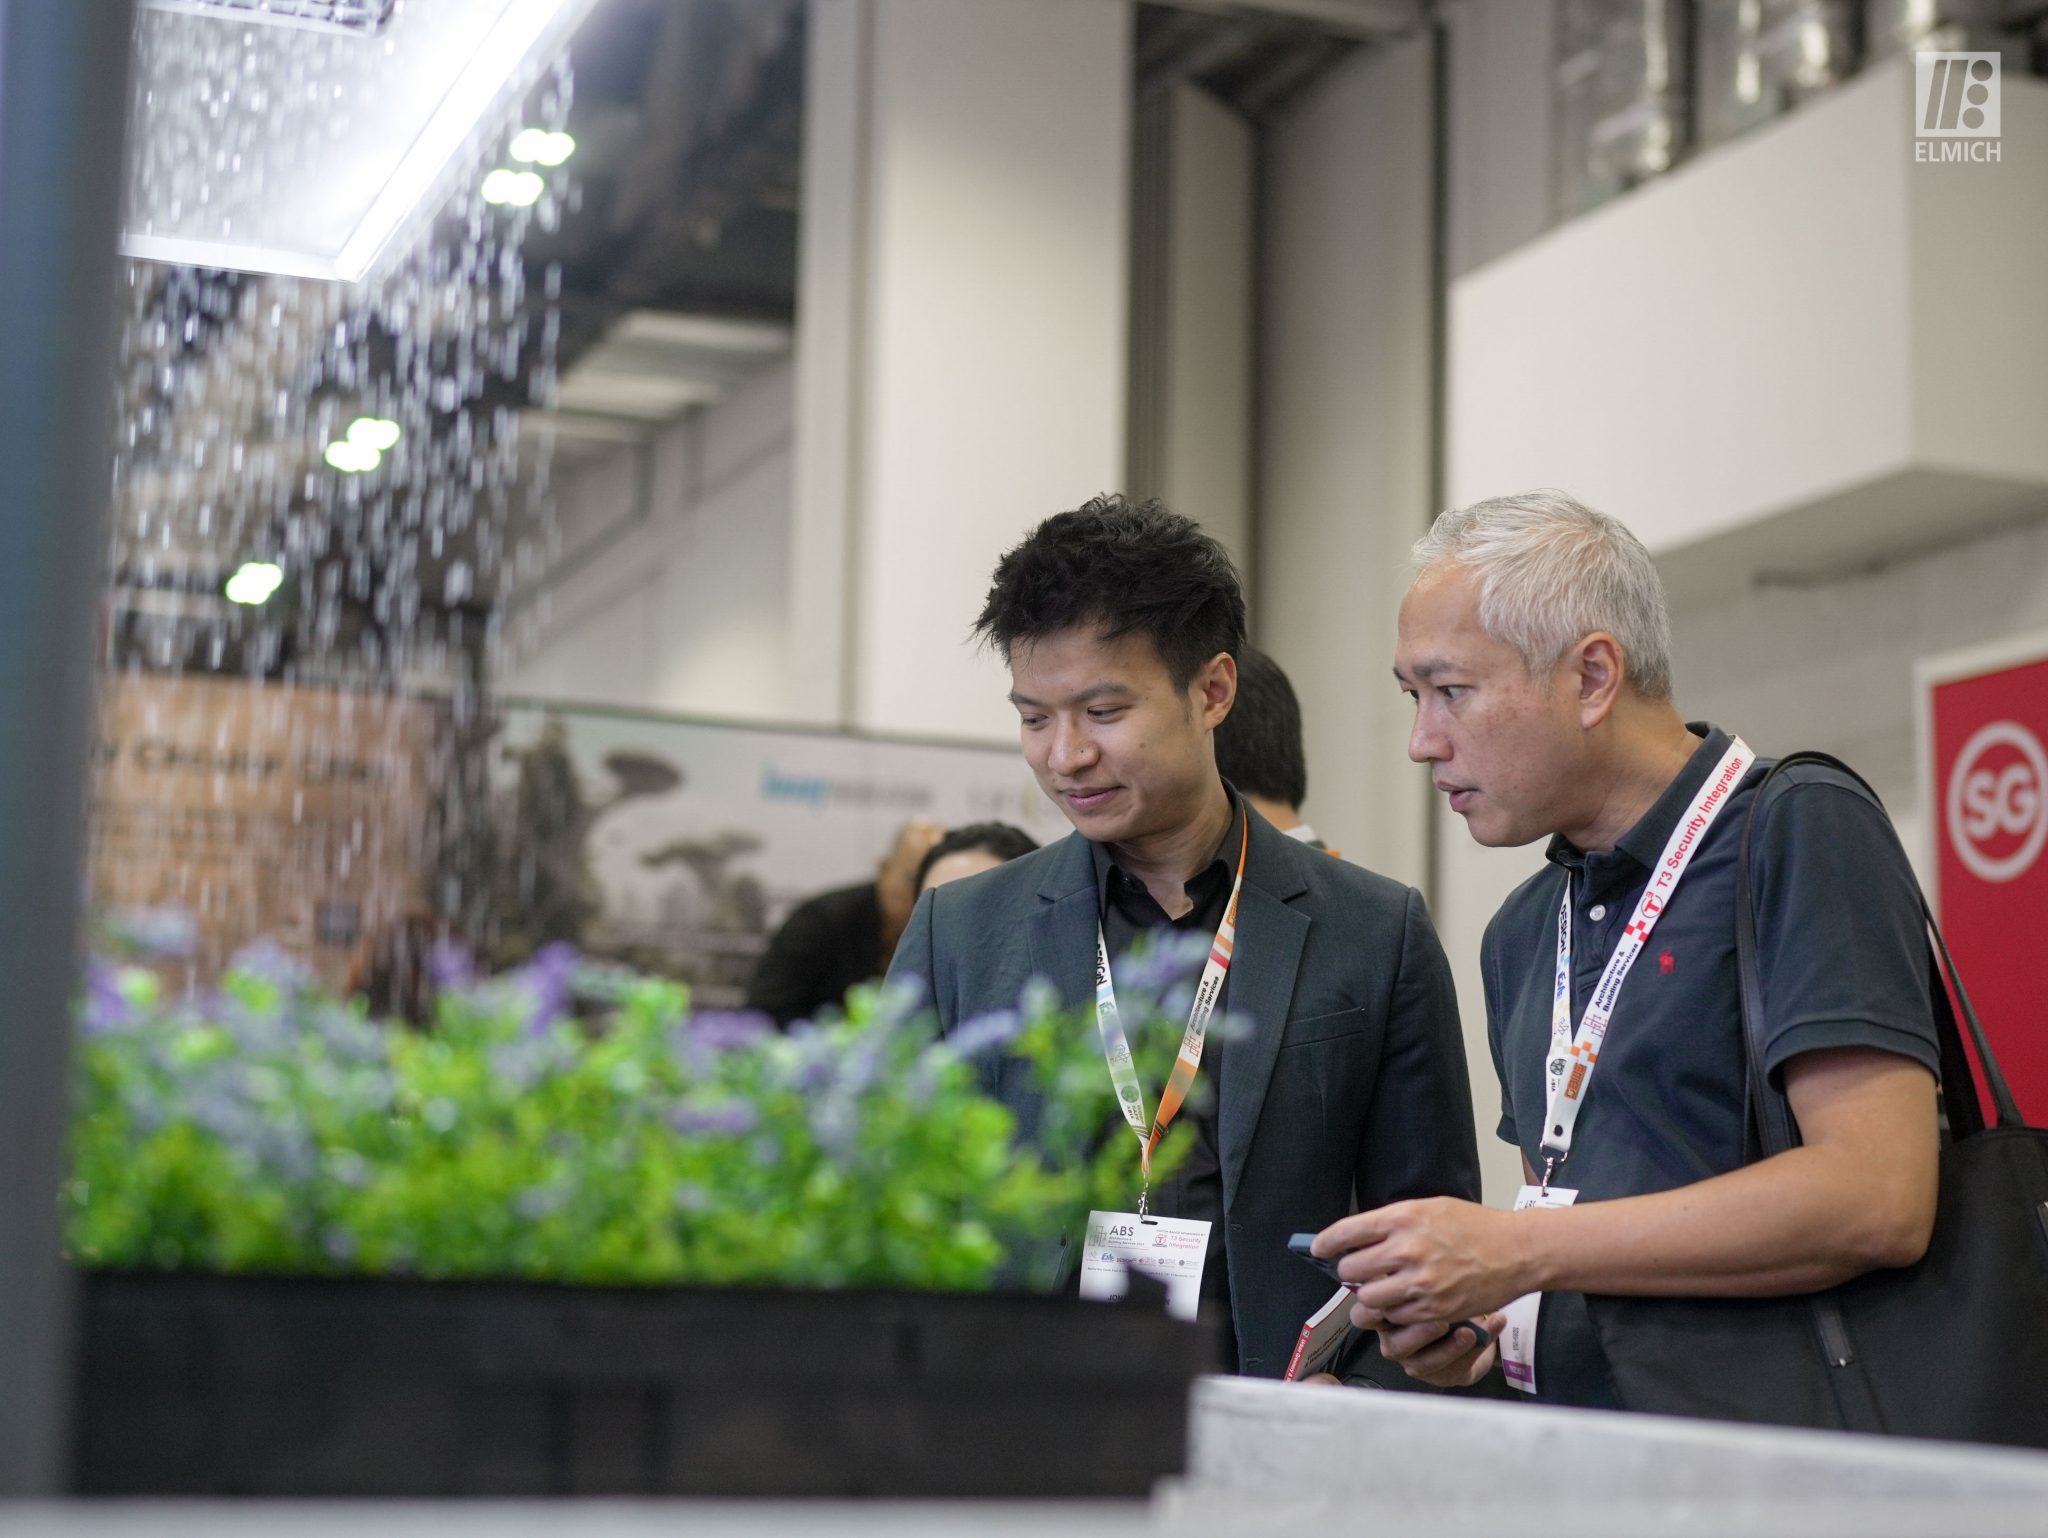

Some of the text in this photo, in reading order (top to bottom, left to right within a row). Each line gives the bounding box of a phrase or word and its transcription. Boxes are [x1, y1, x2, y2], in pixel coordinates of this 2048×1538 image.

[1656, 757, 1744, 888] T3 Security Integration
[1963, 764, 2037, 840] SG
[1205, 976, 1219, 1006] Services
[1595, 958, 1620, 1008] Architecture
[1602, 943, 1639, 1012] Building Services
[1190, 987, 1207, 1032] Architecture
[1109, 1225, 1134, 1236] ABS
